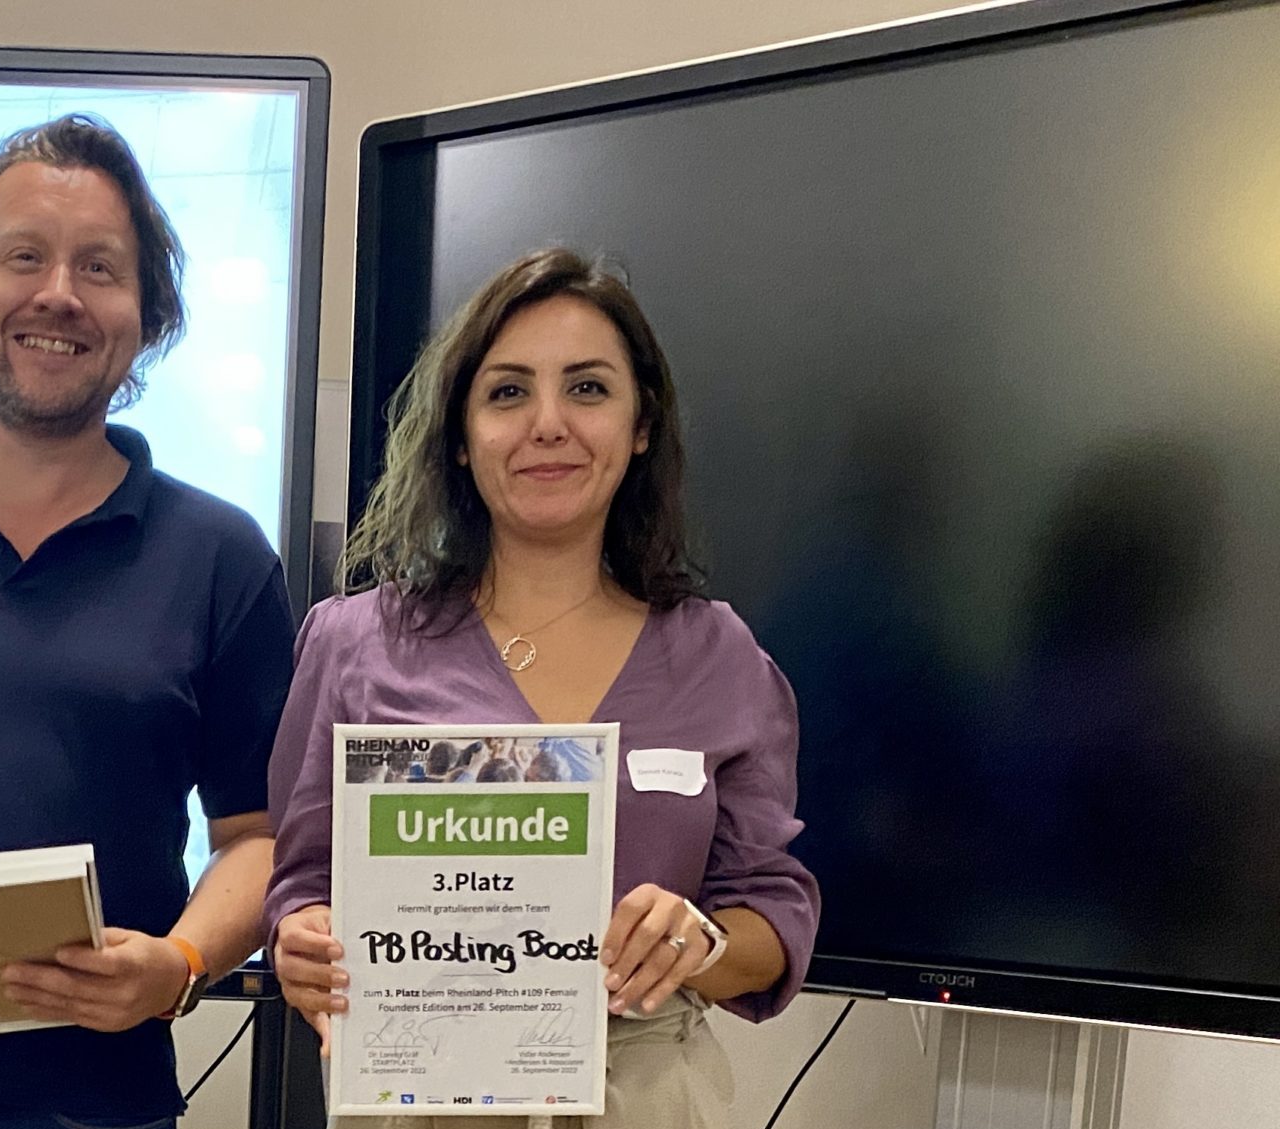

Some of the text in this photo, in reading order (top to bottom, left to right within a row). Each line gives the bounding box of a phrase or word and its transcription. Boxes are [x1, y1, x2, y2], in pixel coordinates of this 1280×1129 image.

[346, 740, 430, 752] RHEINLAND
[397, 807, 569, 842] Urkunde
[432, 871, 515, 892] 3.Platz
[397, 904, 550, 915] Hiermit gratulieren wir dem Team
[359, 930, 599, 973] PB Posting Boost
[919, 972, 976, 988] CTOUCH
[363, 990, 383, 998] zum
[384, 989, 394, 998] 3.
[396, 989, 420, 998] Platz
[422, 989, 445, 998] beim
[447, 989, 519, 998] Rheinland-Pitch
[544, 988, 578, 997] Female
[378, 1003, 420, 1012] Founders
[422, 1003, 455, 1012] Edition
[489, 1003, 539, 1013] September
[541, 1002, 562, 1012] 2022
